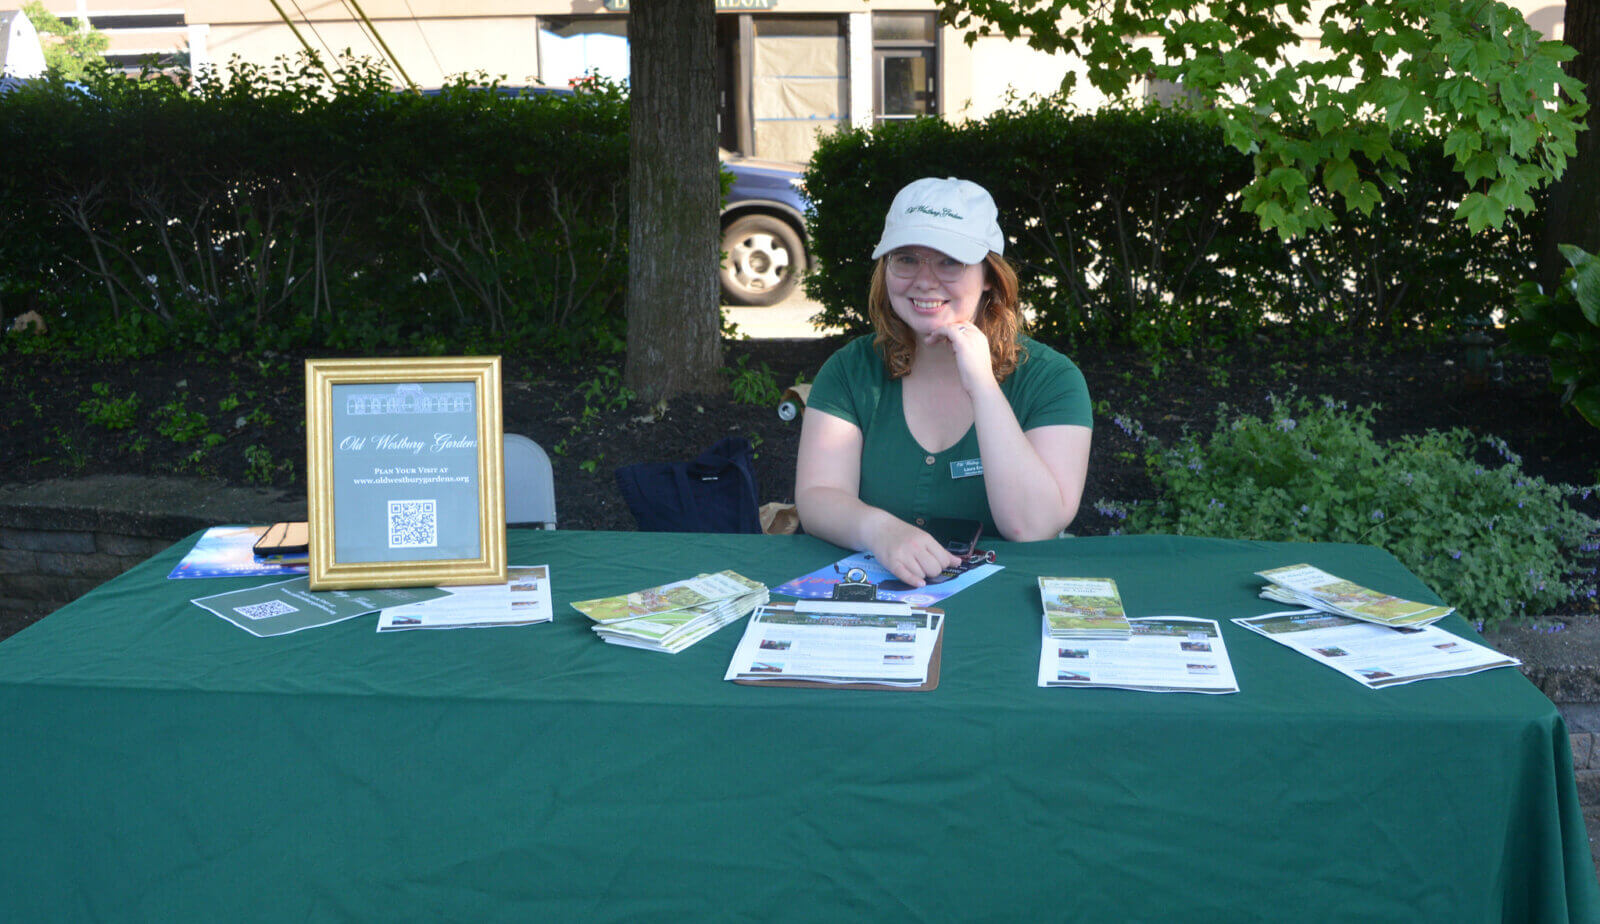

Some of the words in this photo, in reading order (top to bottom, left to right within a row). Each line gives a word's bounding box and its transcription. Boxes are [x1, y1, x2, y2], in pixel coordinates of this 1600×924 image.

[339, 435, 366, 451] Old
[370, 432, 424, 454] Westbury
[374, 466, 394, 475] PLAN
[395, 466, 416, 475] YOUR
[418, 466, 438, 475] VISIT
[439, 466, 449, 474] AT
[353, 475, 470, 485] www.oldwestburygardens.org
